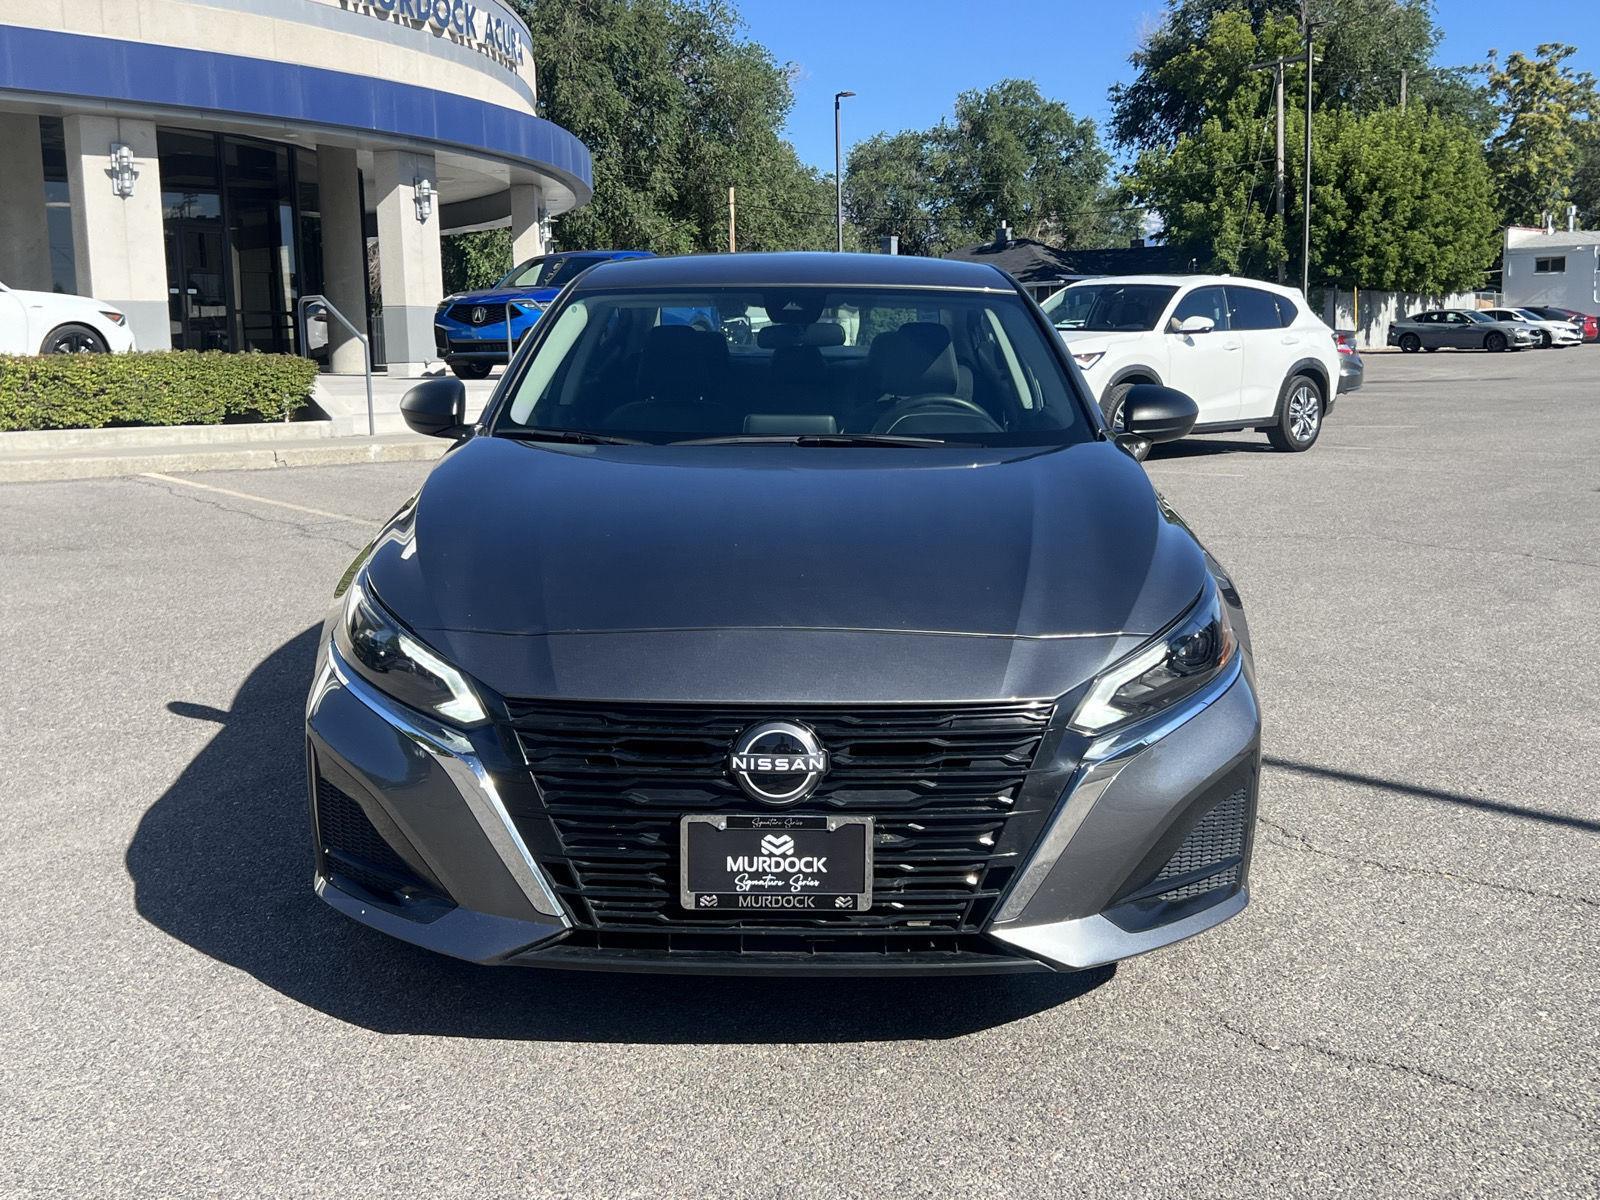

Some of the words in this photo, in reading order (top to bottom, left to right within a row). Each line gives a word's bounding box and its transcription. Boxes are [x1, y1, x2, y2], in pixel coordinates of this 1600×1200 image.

[484, 12, 524, 66] ACURA
[732, 756, 824, 771] NISSAN
[751, 816, 783, 828] Signature
[784, 816, 803, 828] Series
[726, 856, 828, 873] MURDOCK
[734, 873, 784, 892] Signature
[789, 873, 820, 892] Series
[738, 895, 815, 908] MURDOCK
